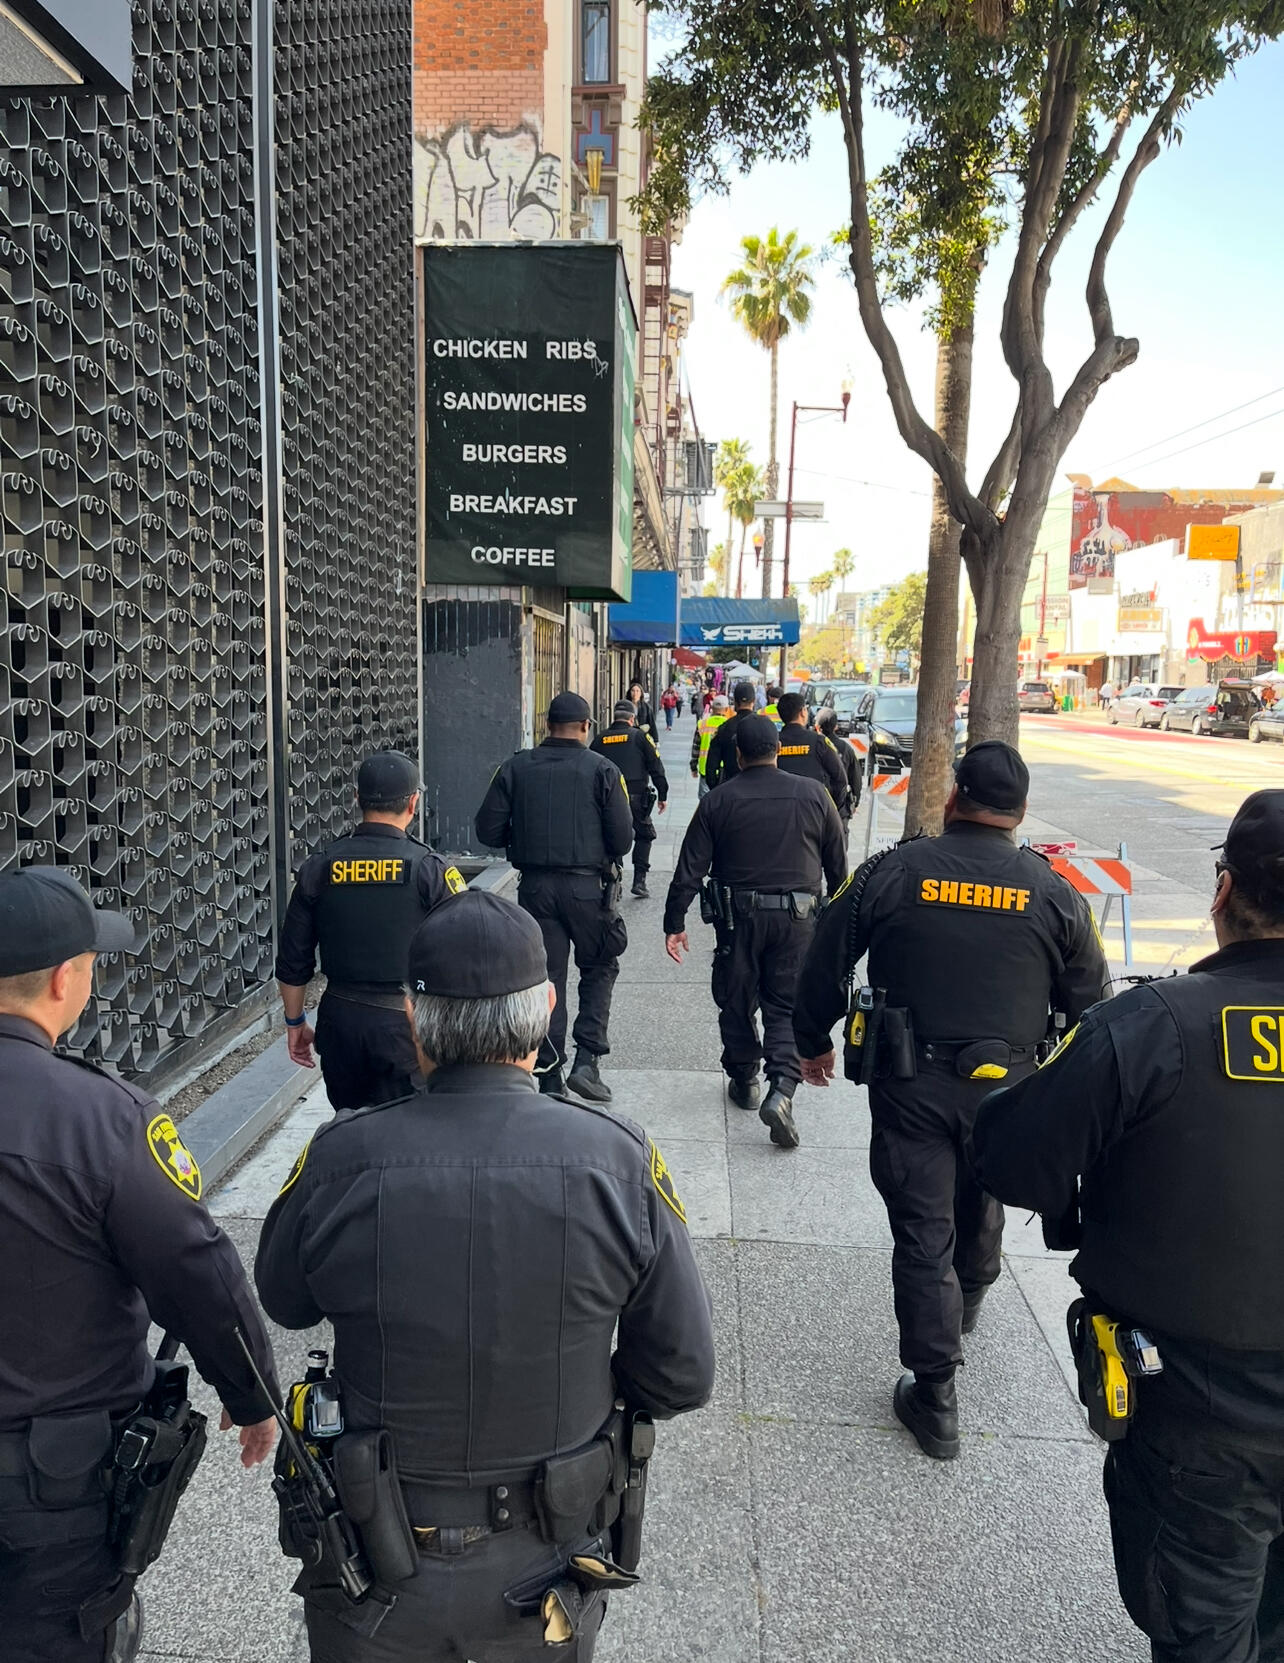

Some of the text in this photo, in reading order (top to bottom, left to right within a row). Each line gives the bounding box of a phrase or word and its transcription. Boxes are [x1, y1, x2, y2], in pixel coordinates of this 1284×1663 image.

[433, 339, 597, 359] CHICKEN RIBS
[443, 391, 587, 413] SANDWICHES
[462, 444, 567, 464] BURGERS
[450, 494, 578, 515] BREAKFAST
[470, 546, 555, 567] COFFEE
[602, 734, 629, 744] SHERIFF
[332, 859, 403, 883] SHERIFF
[921, 878, 1030, 911] SHERIFF
[1250, 1014, 1284, 1073] S
